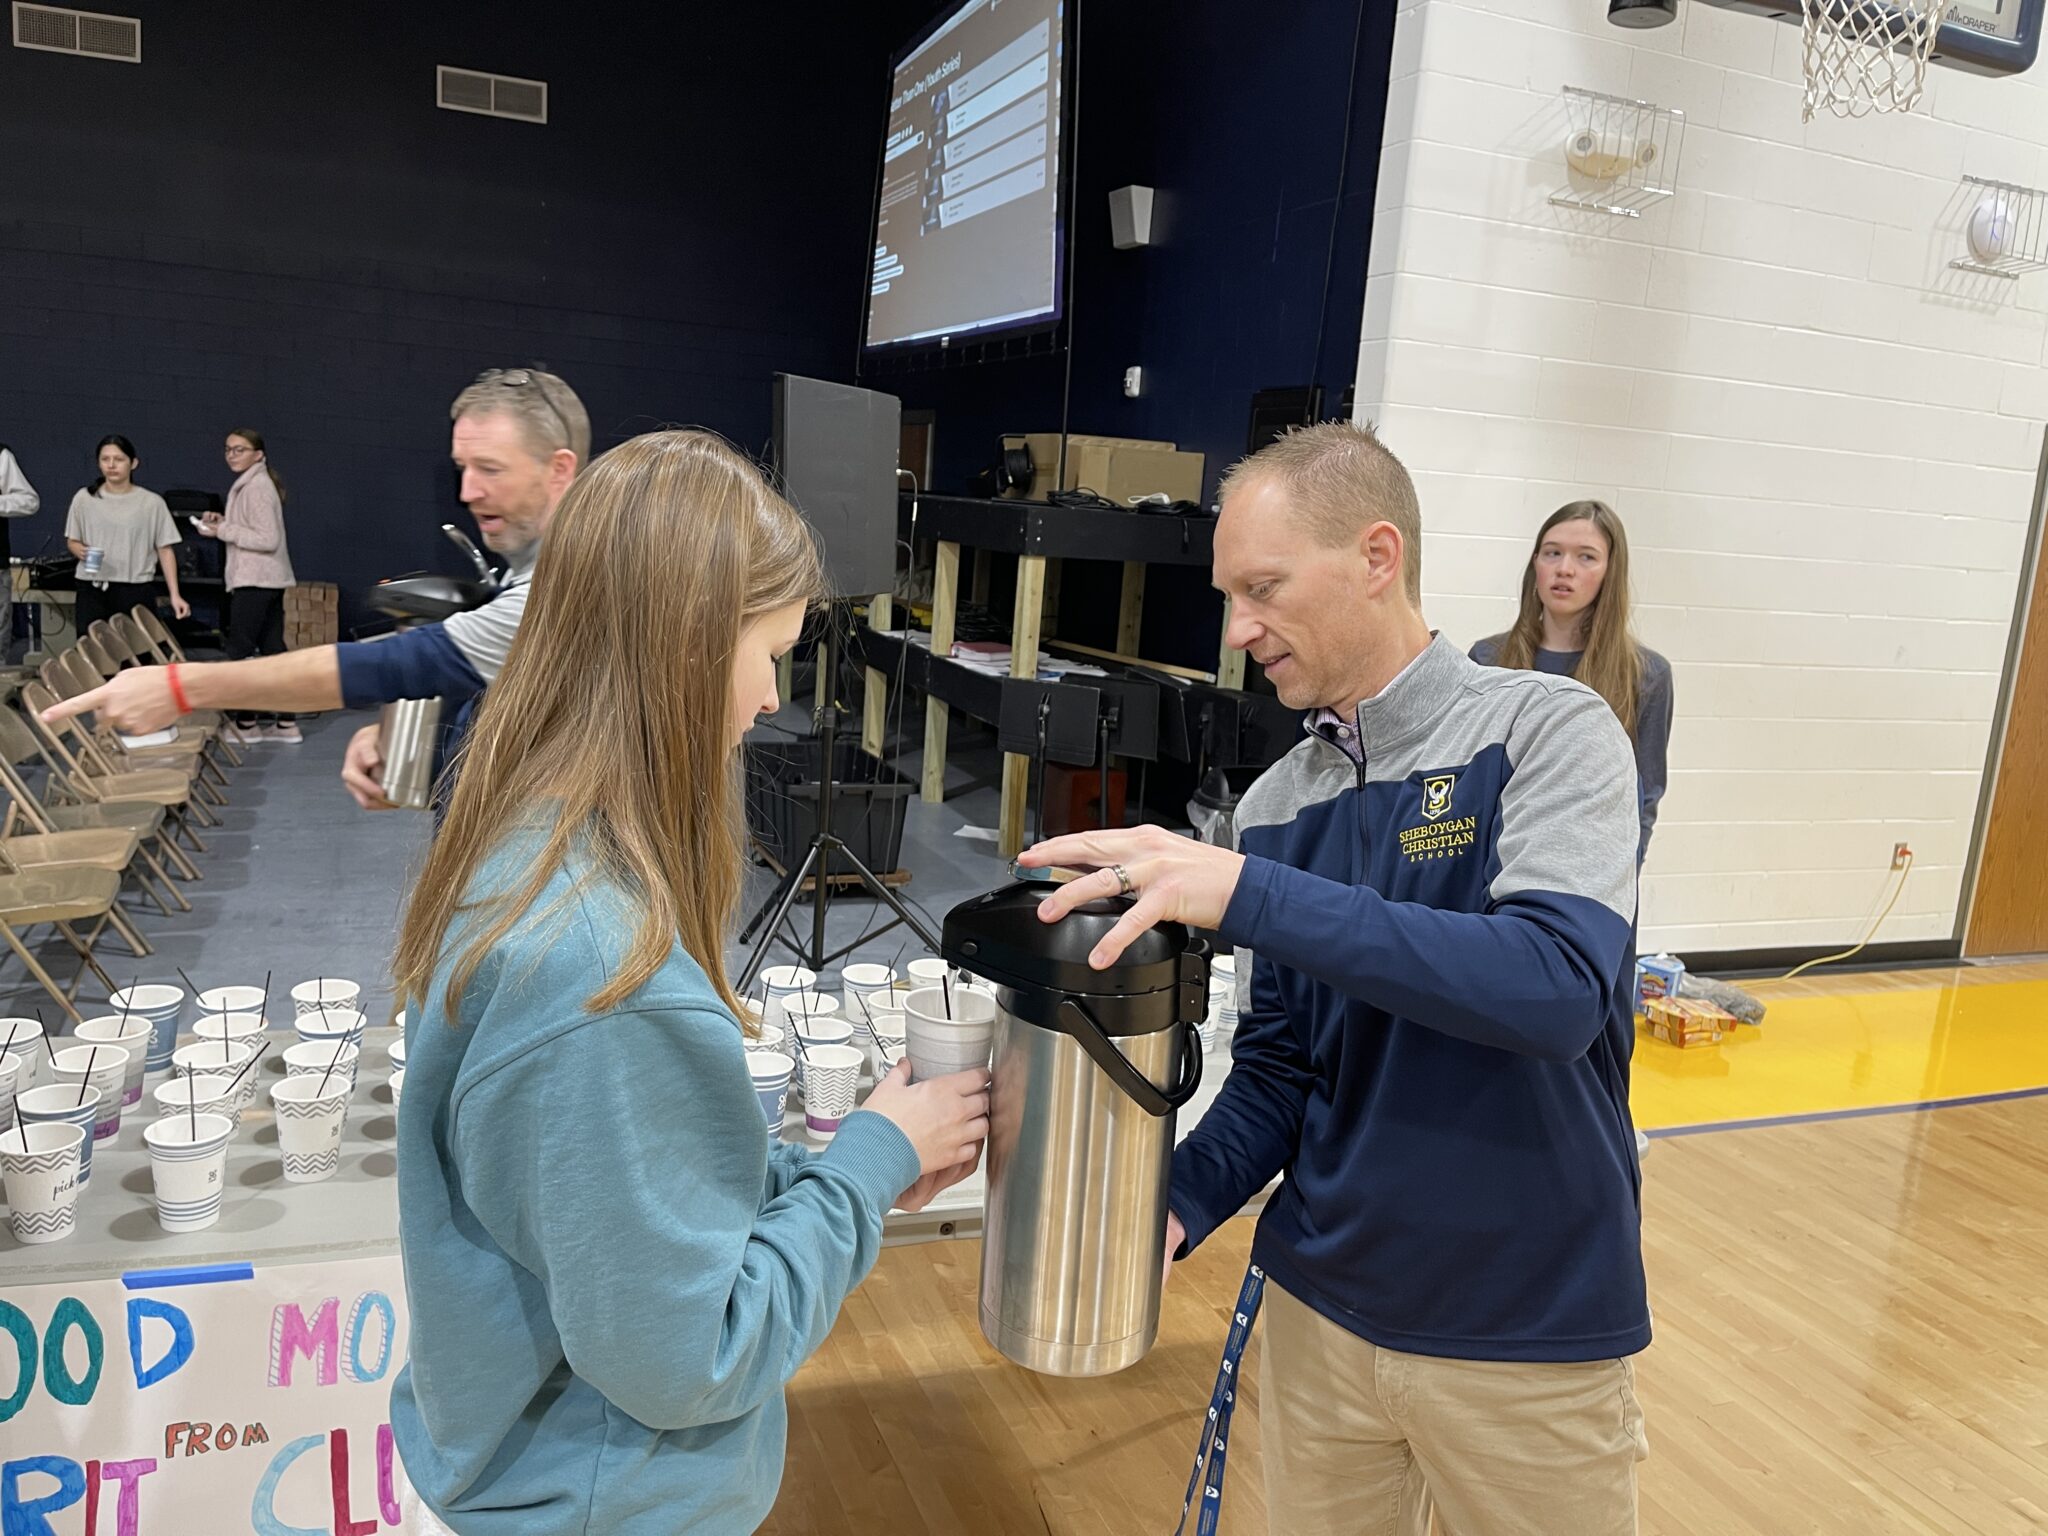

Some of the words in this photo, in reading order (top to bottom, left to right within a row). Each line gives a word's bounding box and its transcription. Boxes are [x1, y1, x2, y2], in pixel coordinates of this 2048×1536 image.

[1962, 15, 1995, 32] DRAPER
[1399, 816, 1475, 843] SHEBOYGAN
[1402, 831, 1475, 854] CHRISTIAN
[1410, 847, 1463, 862] SCHOOL
[165, 1421, 270, 1458] FROM
